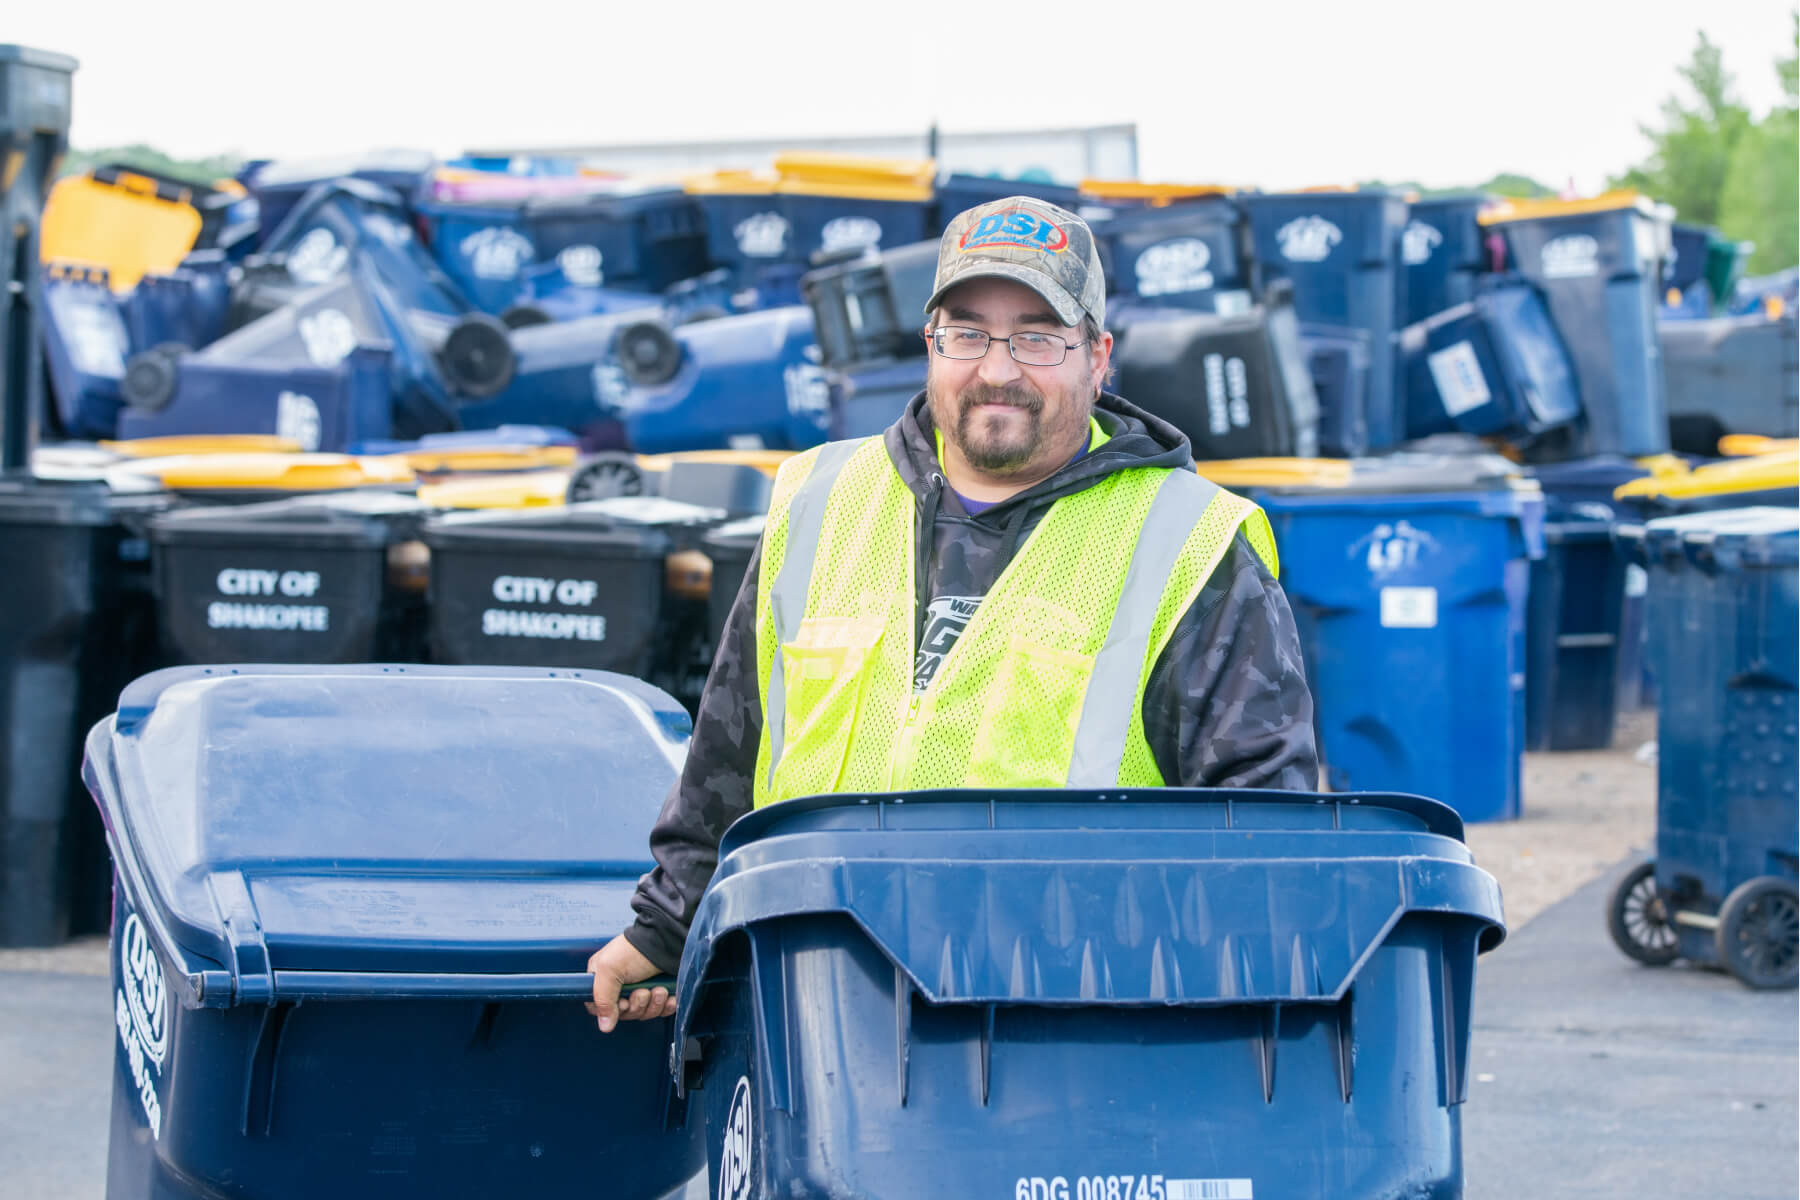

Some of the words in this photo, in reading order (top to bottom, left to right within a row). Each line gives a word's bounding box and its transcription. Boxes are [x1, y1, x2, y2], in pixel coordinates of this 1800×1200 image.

[972, 213, 1055, 244] DSI
[217, 568, 278, 596] CITY
[280, 570, 321, 597] OF
[493, 575, 556, 604] CITY
[556, 578, 598, 606] OF
[208, 601, 329, 632] SHAKOPEE
[482, 608, 606, 641] SHAKOPEE
[130, 917, 165, 1038] DSI
[724, 1088, 749, 1200] DSI
[1015, 1176, 1070, 1200] 6DG
[1076, 1174, 1165, 1200] 008745
